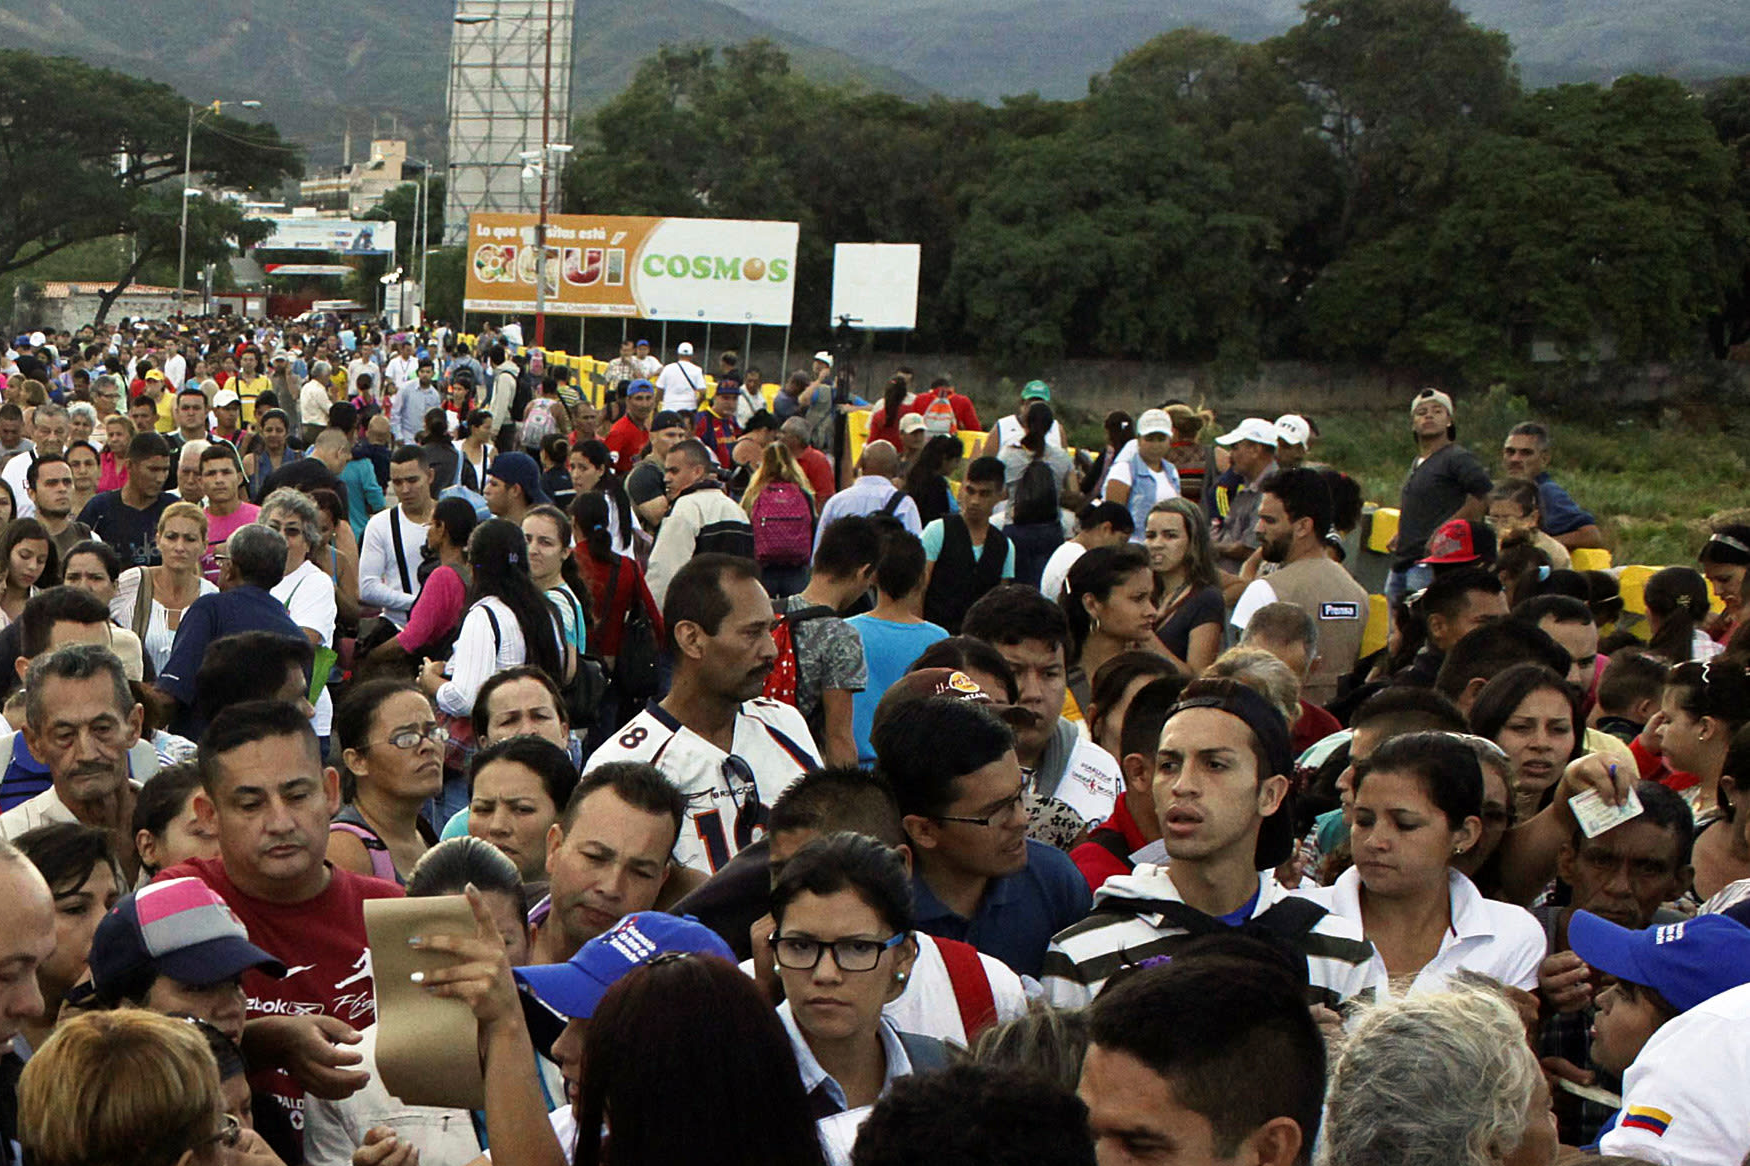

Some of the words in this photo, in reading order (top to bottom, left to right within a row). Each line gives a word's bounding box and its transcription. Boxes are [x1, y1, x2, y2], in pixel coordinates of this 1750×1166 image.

[476, 223, 492, 237] Lo
[493, 227, 517, 240] que
[578, 226, 607, 240] está
[474, 231, 627, 299] aquí
[643, 253, 789, 283] COSMOS
